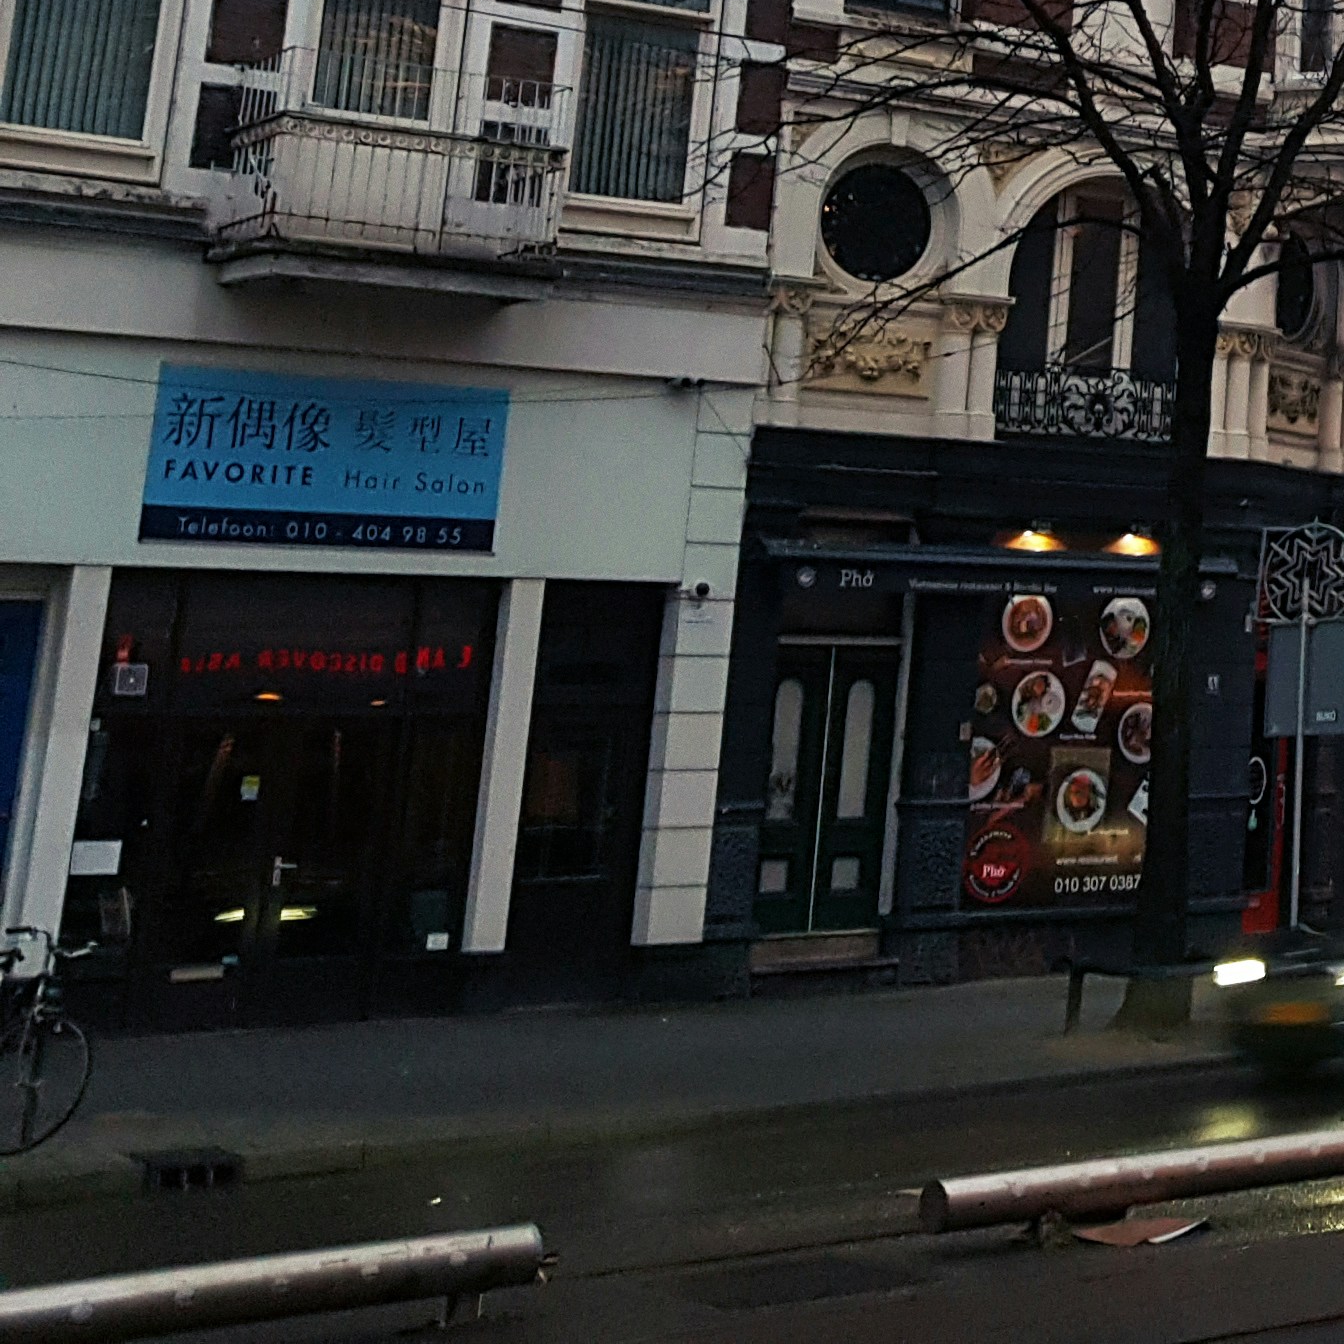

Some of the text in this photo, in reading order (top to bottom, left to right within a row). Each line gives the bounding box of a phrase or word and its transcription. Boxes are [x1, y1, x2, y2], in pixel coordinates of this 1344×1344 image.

[161, 392, 331, 453] 新偶像
[163, 458, 486, 495] FAVORITE Hair Salon
[286, 522, 328, 541] 010
[352, 524, 392, 543] 404
[403, 526, 428, 544] 98
[436, 528, 462, 546] 55
[1054, 873, 1142, 894] 010 307 0387
